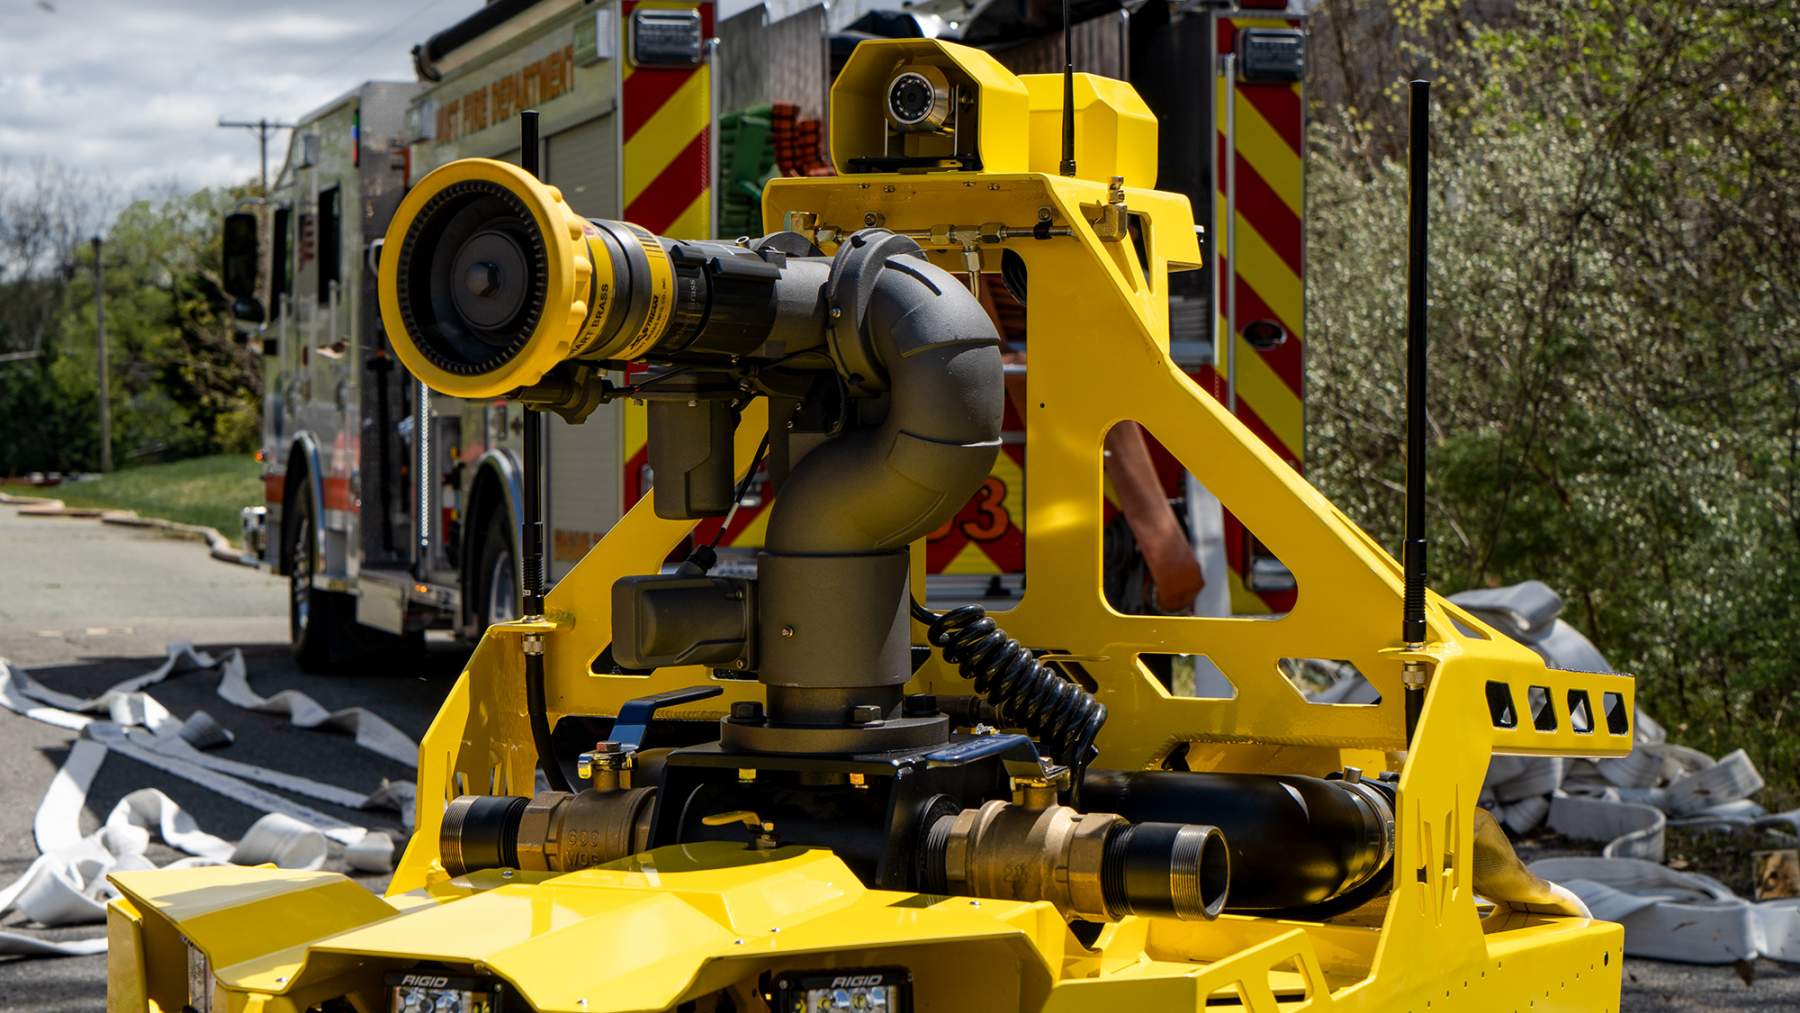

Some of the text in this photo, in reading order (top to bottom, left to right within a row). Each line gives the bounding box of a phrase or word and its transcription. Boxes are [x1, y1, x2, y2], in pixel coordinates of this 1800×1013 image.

[591, 283, 609, 327] BRASS
[401, 974, 449, 988] RIGID
[831, 974, 884, 988] RIGID
